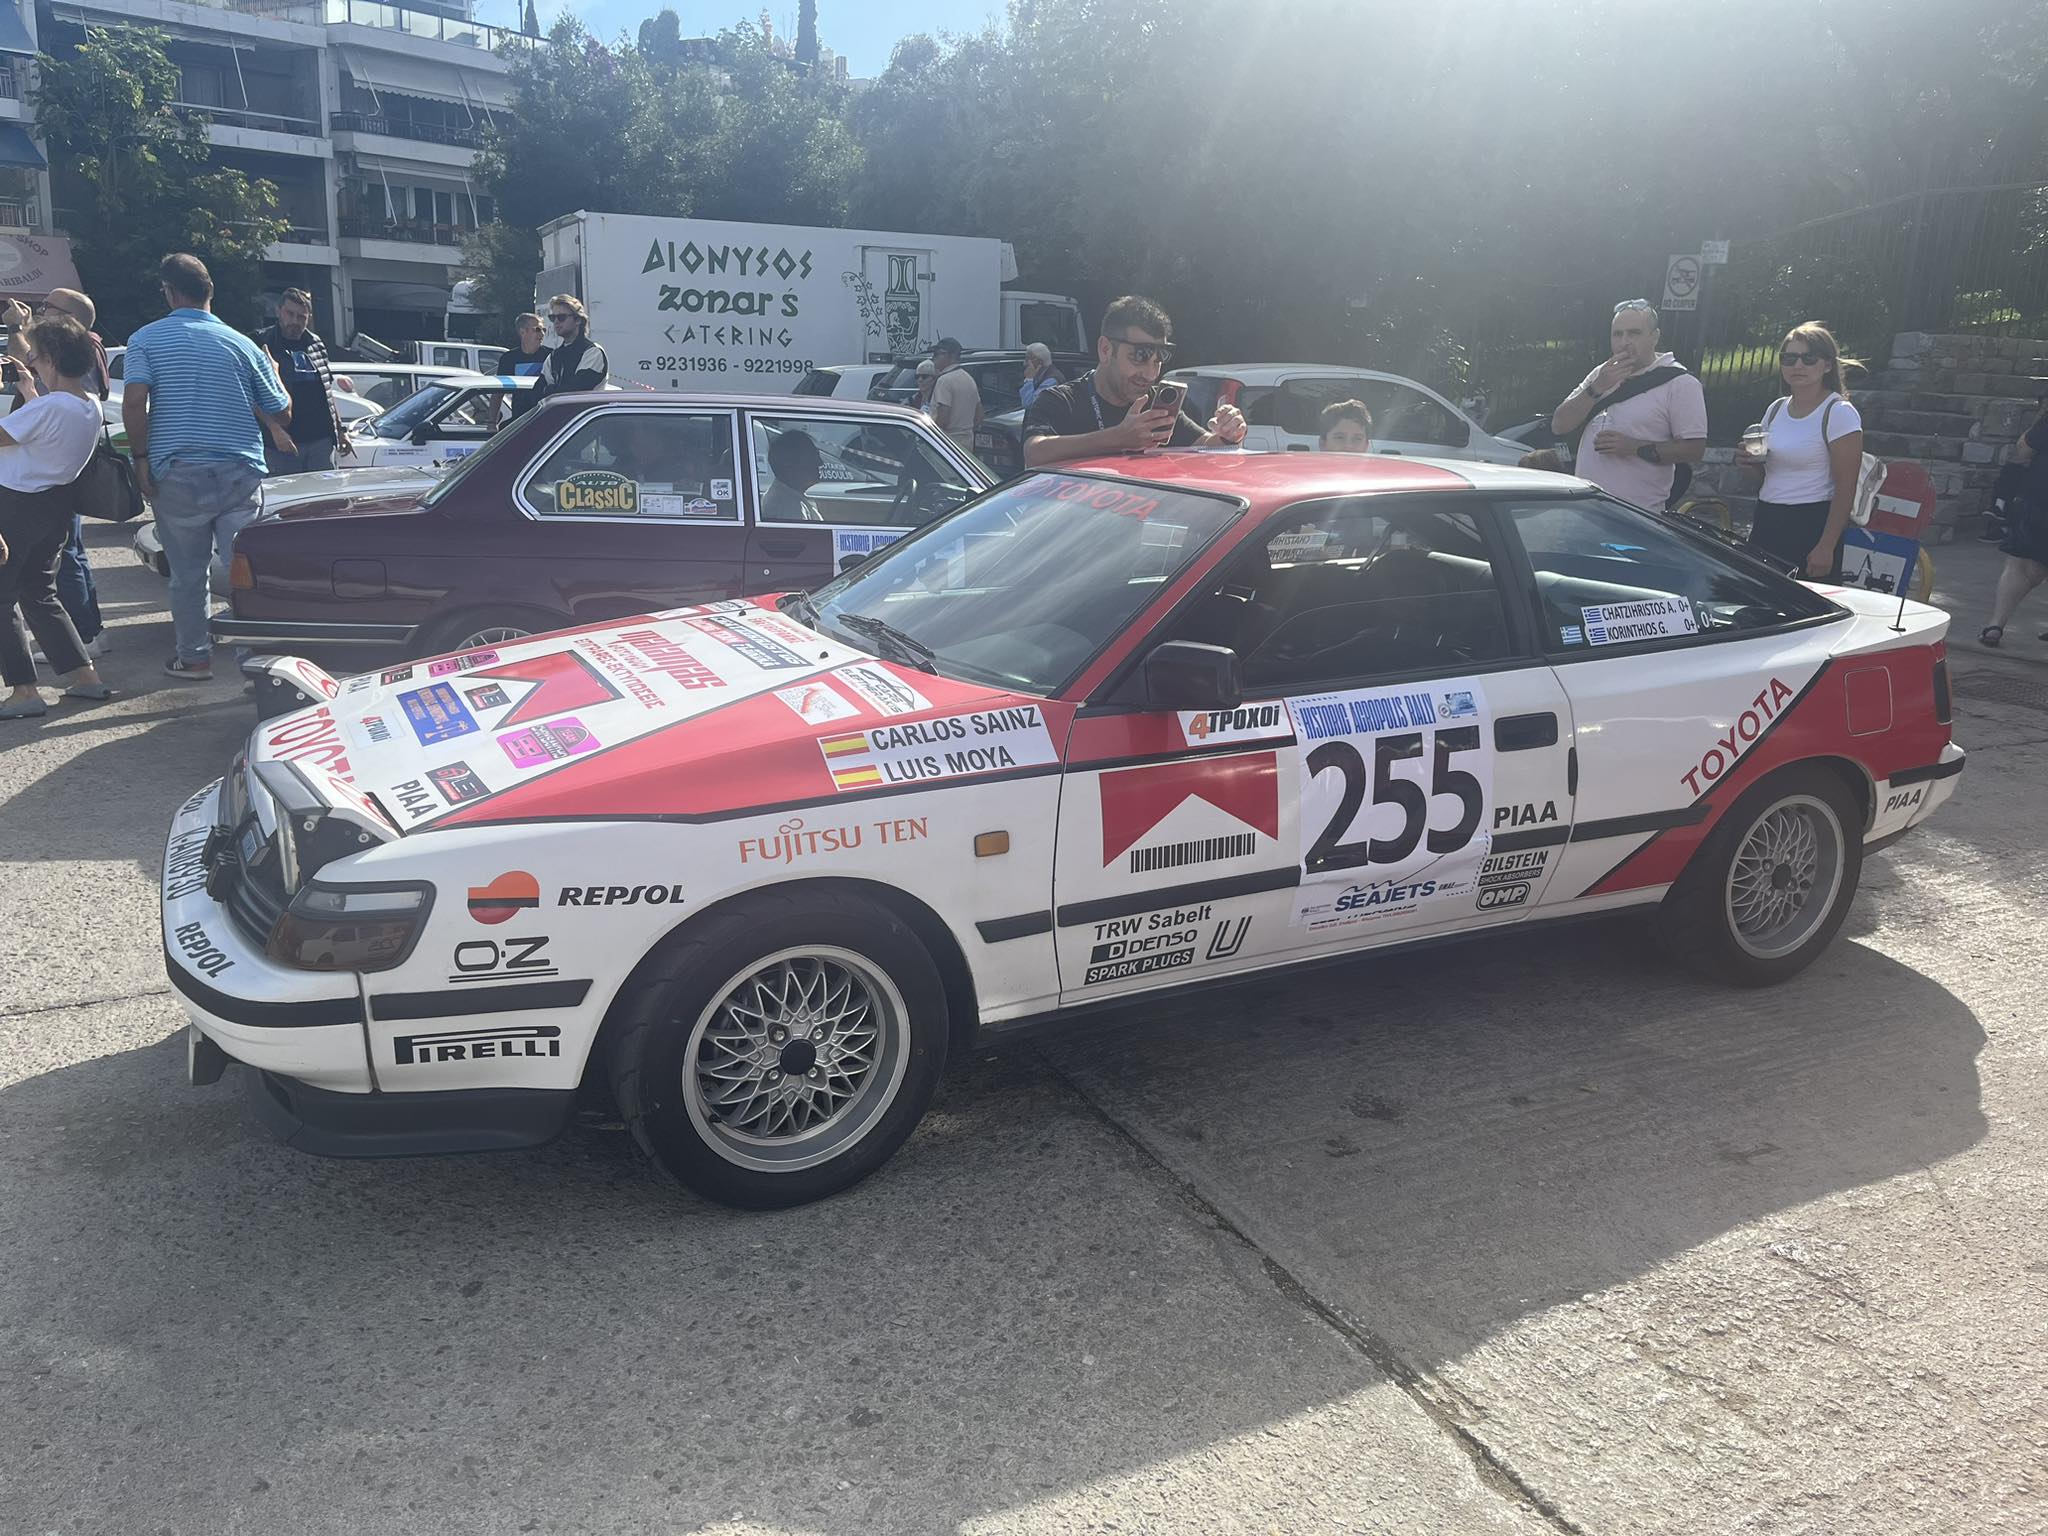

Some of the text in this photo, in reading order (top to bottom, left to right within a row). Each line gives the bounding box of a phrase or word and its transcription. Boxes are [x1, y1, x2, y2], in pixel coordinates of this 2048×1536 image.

[16, 235, 48, 256] SHOP
[664, 324, 792, 348] CATERING
[656, 357, 727, 373] 9231936
[744, 359, 813, 375] 9221998
[1046, 481, 1161, 520] TOYOTA
[839, 534, 870, 552] HISTORIC
[1602, 602, 1666, 621] CHATZIHRISTOS
[1668, 601, 1677, 613] A.
[1607, 623, 1657, 641] KORINTHIOS
[1659, 622, 1669, 634] G.
[871, 706, 1041, 751] CARLOS SAINZ
[1300, 703, 1352, 740] HISTORIC
[1404, 693, 1437, 726] RALLY
[1680, 677, 1793, 797] TOYOTA
[884, 745, 1016, 782] LUIS MOYA
[391, 779, 438, 819] PIAA
[1305, 725, 1483, 874] 255
[1494, 800, 1557, 829] PIAA
[1883, 788, 1921, 813] PIAA
[739, 817, 928, 865] FUJITSU TEN
[1482, 850, 1548, 874] BILSTEIN
[557, 885, 684, 906] REPSOL
[1335, 881, 1436, 912] SEAJETS
[1479, 885, 1527, 908] OMP
[1094, 905, 1212, 940] TRW Sabelt
[175, 921, 235, 979] REPSOL
[1129, 929, 1197, 954] DENSO
[1088, 951, 1191, 983] SPARK PLUGS
[393, 1026, 561, 1065] PIRELLI
